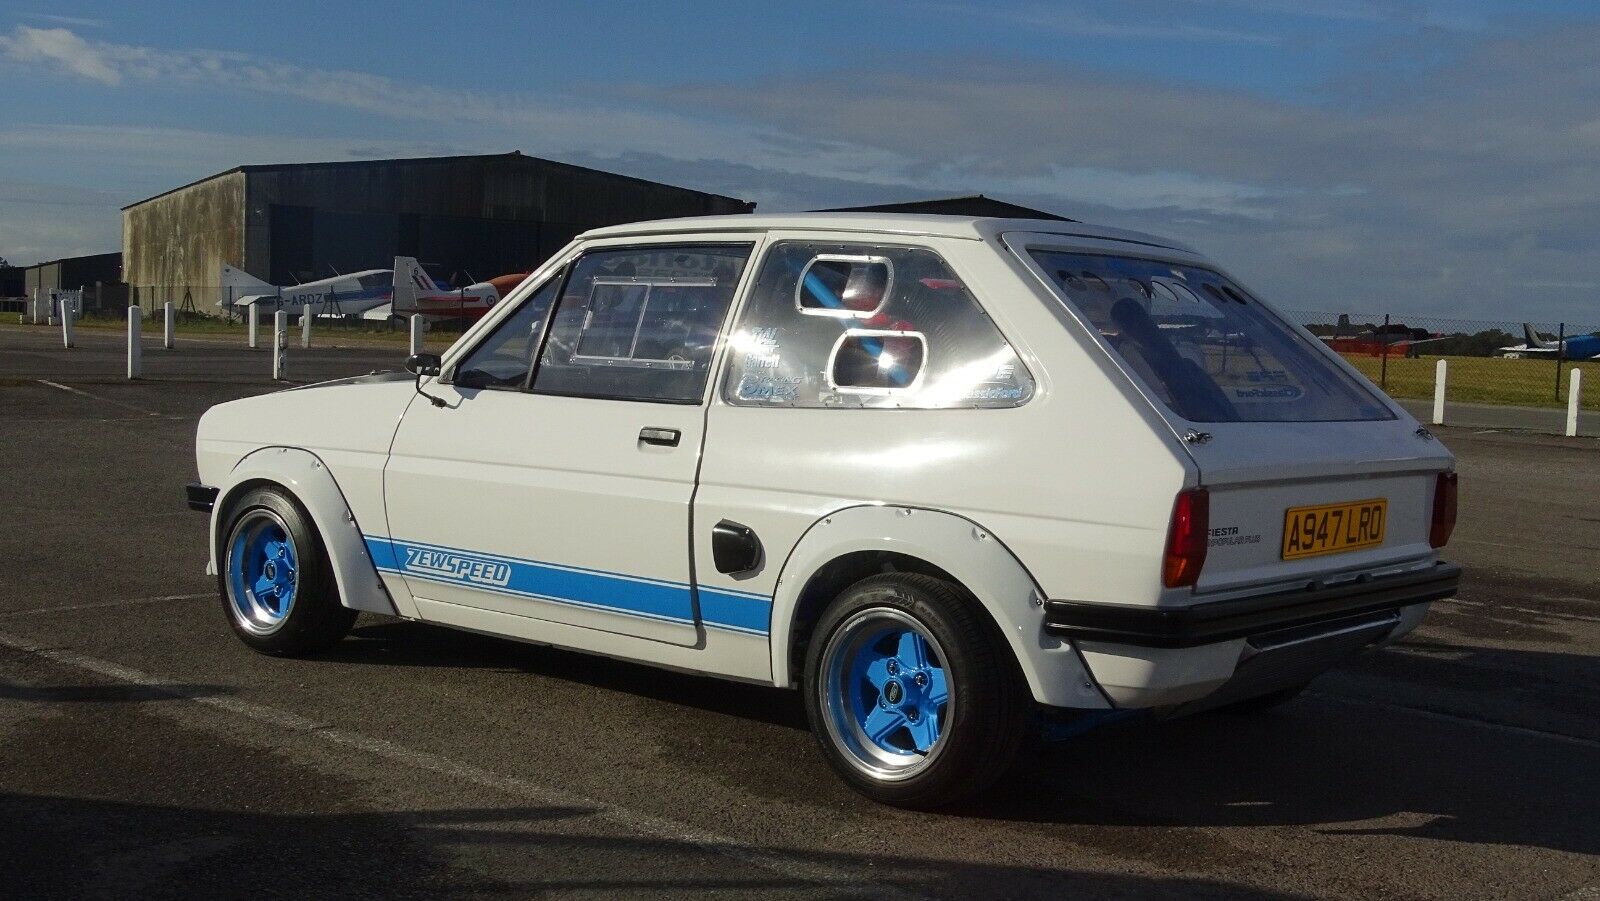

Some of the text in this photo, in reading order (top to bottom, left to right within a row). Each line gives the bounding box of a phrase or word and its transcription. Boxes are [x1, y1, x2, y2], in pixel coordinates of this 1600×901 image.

[1208, 527, 1239, 537] FIESTA
[1287, 505, 1382, 553] A947 LRO
[405, 548, 512, 586] ZEWSPEED
